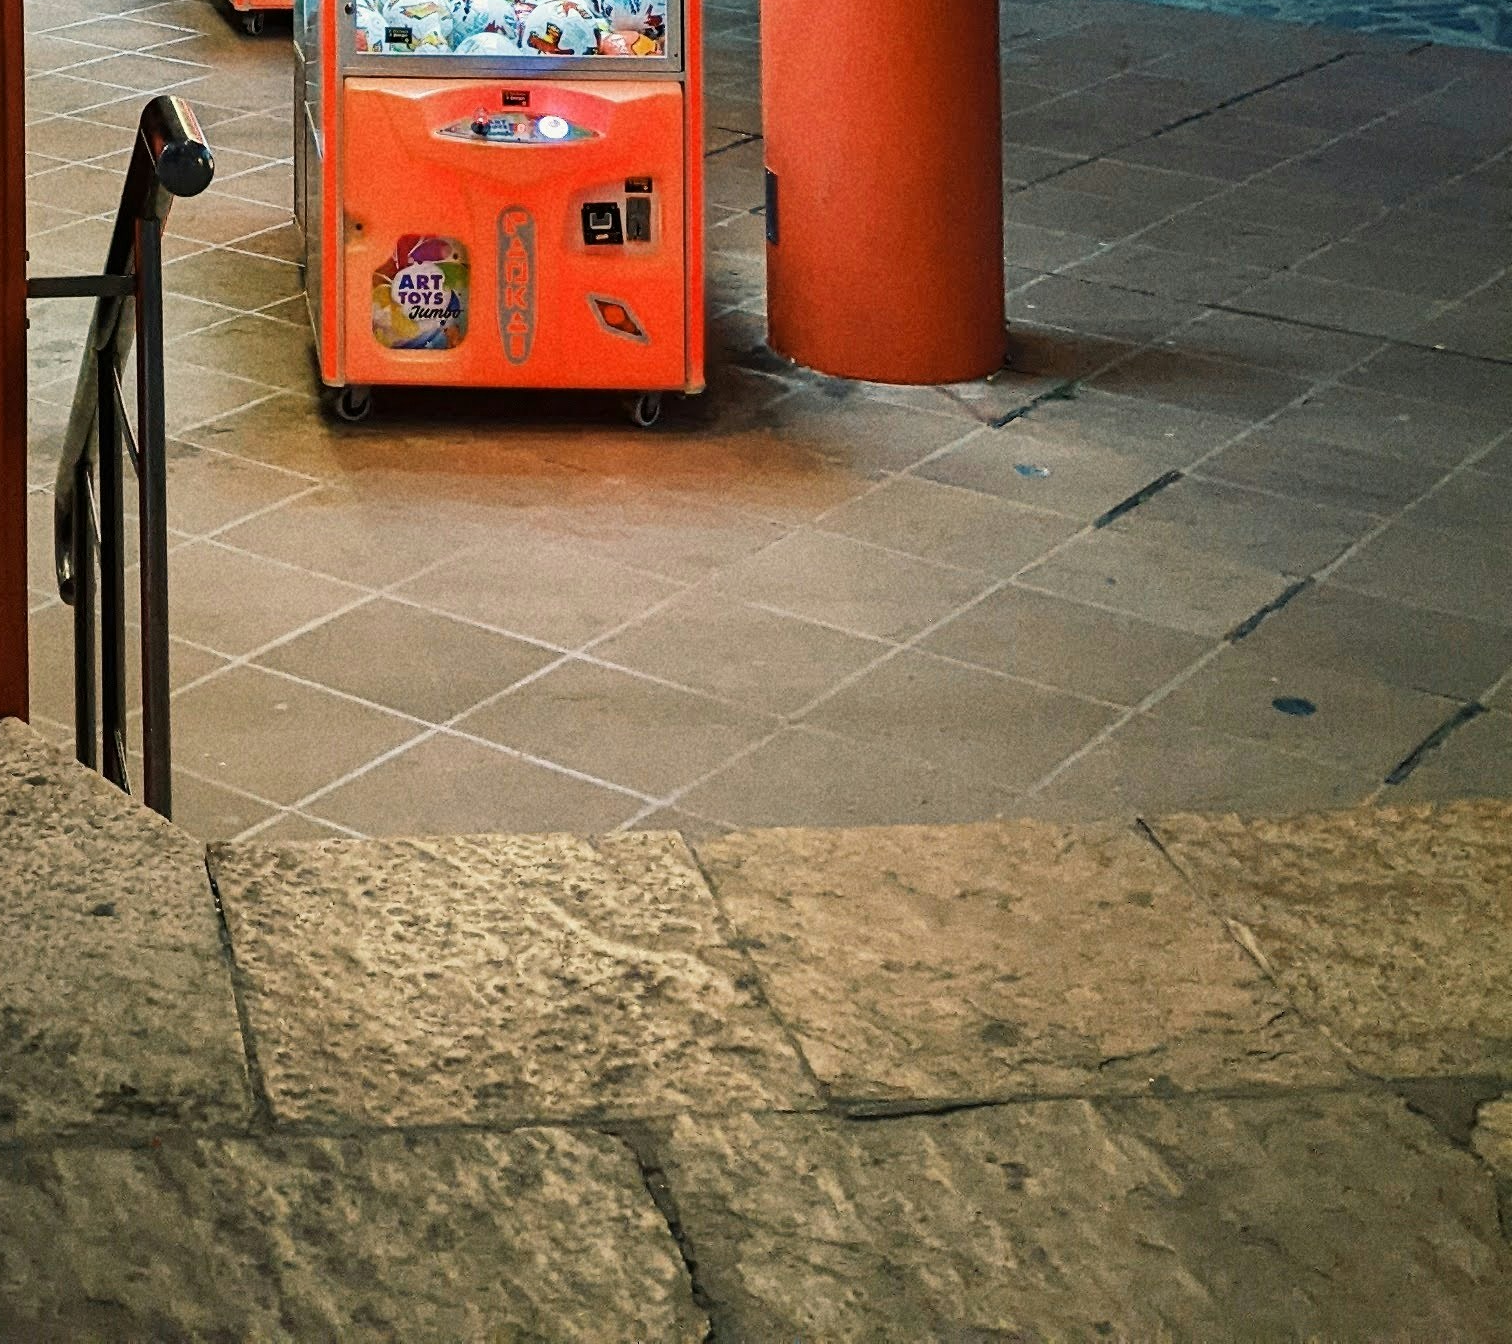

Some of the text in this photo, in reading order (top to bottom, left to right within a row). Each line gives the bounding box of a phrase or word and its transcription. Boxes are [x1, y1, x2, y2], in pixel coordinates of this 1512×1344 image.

[398, 274, 444, 290] ART
[398, 292, 444, 305] TOYS
[408, 305, 464, 320] Jumbo
